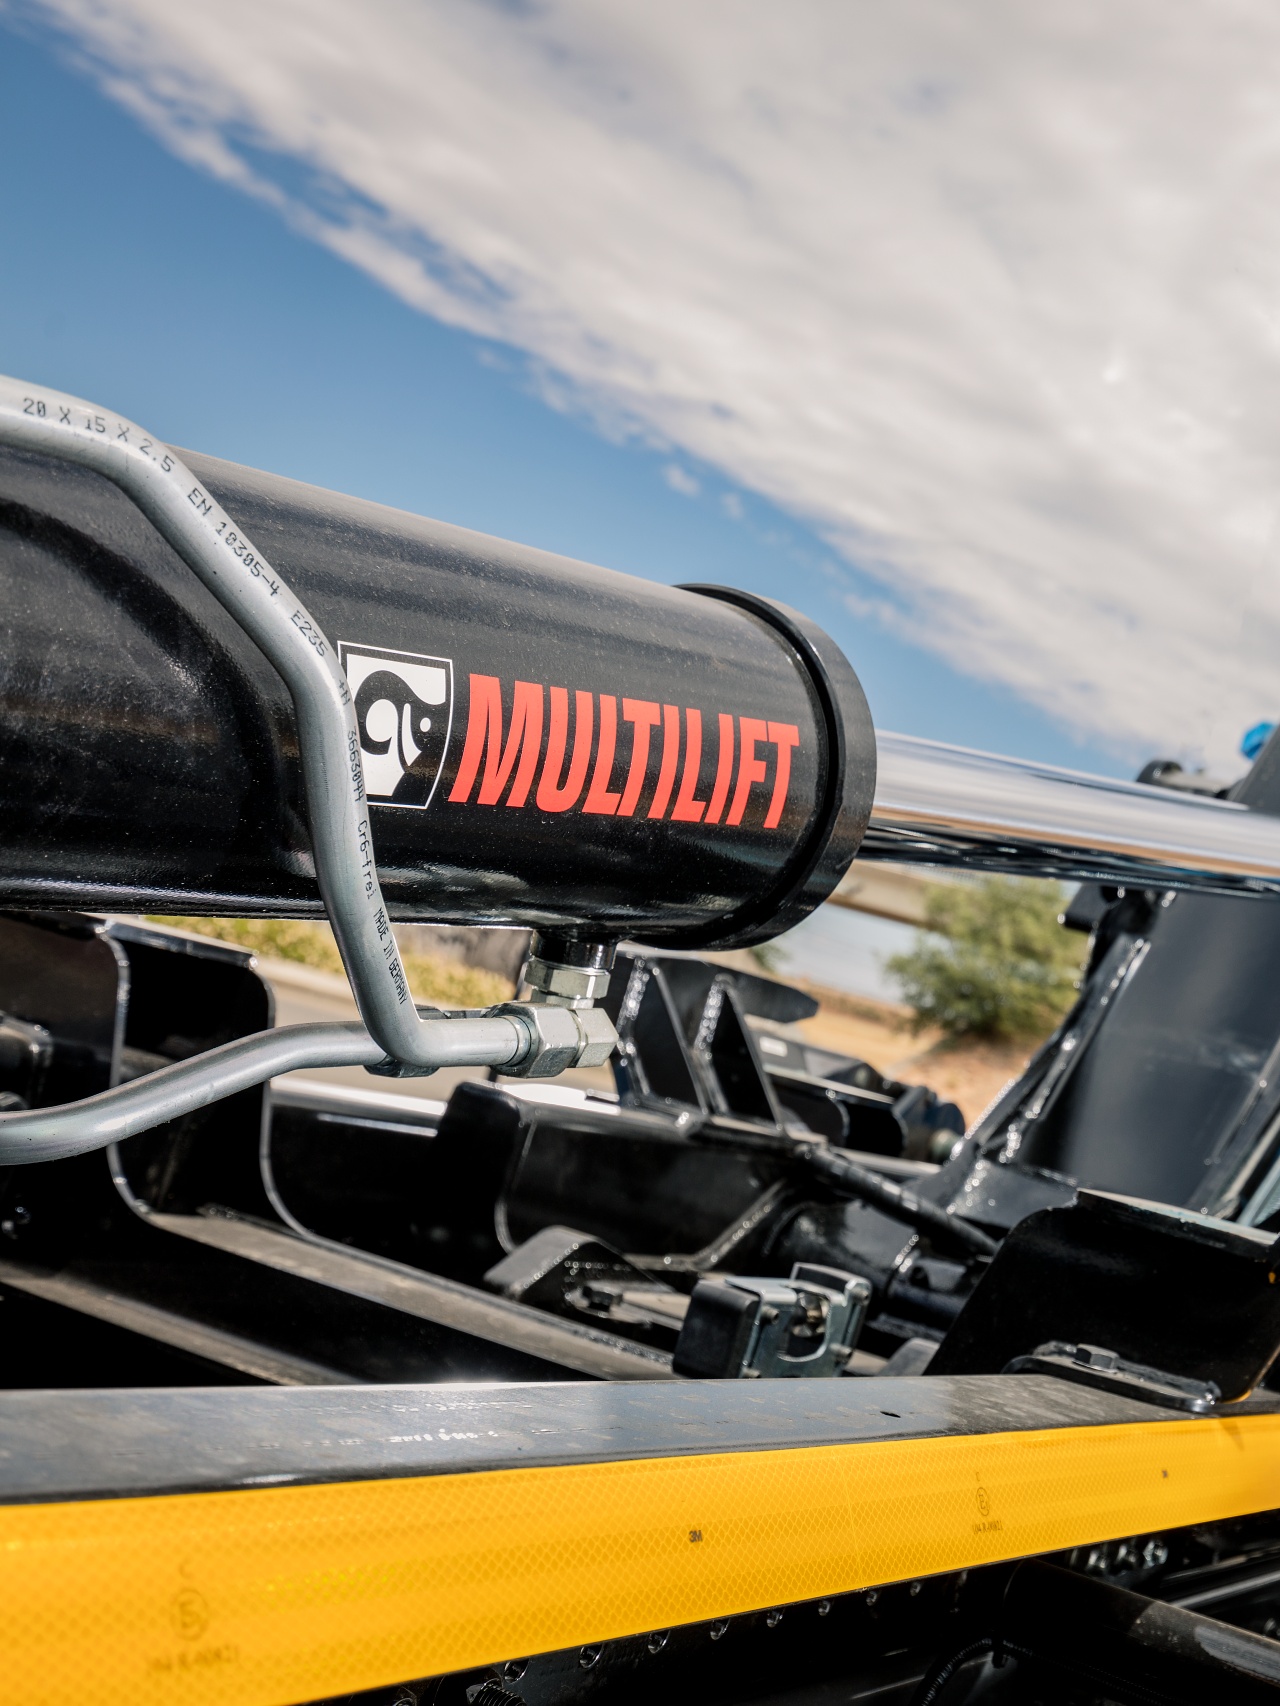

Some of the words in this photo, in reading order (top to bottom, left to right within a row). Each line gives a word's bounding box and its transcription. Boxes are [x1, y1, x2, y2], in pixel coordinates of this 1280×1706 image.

[23, 397, 46, 418] 20
[59, 406, 71, 425] X
[85, 415, 106, 433] 15
[117, 424, 130, 442] X
[139, 438, 175, 473] 2.5
[187, 487, 213, 517] EN
[215, 521, 281, 597] 10305-4
[290, 609, 328, 657] E235
[348, 725, 365, 802] 3663044
[358, 820, 377, 899] Cr6-frei
[373, 907, 389, 941] MADE
[383, 939, 395, 960] IN
[389, 957, 408, 1005] GERMANY
[448, 672, 800, 829] MULTILIFT
[689, 1529, 703, 1543] 3M
